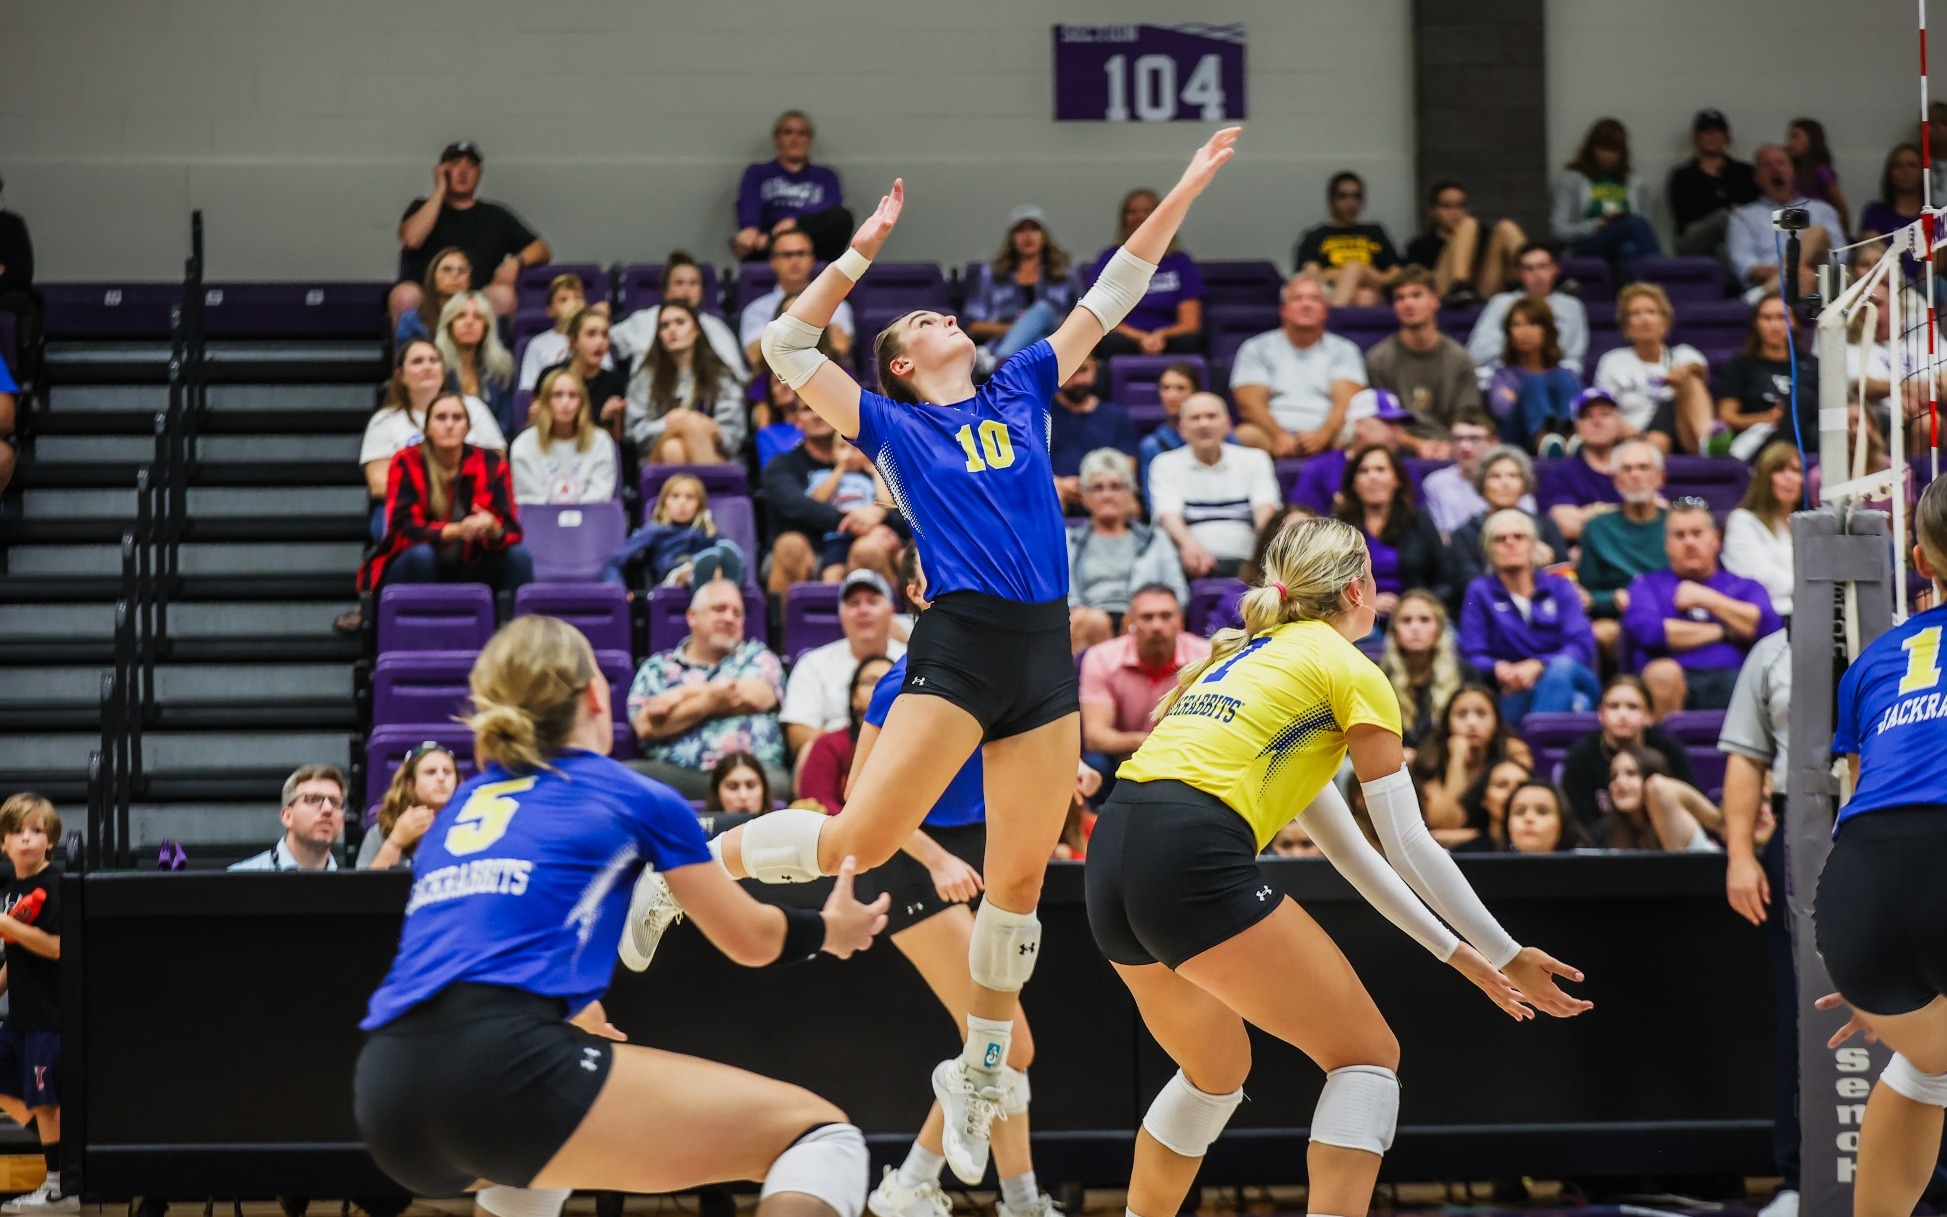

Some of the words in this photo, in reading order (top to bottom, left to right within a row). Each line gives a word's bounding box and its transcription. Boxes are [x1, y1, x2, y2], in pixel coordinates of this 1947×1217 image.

[1103, 53, 1226, 121] 104
[955, 419, 1016, 473] 10
[1898, 625, 1943, 697] 1
[444, 774, 539, 857] 5
